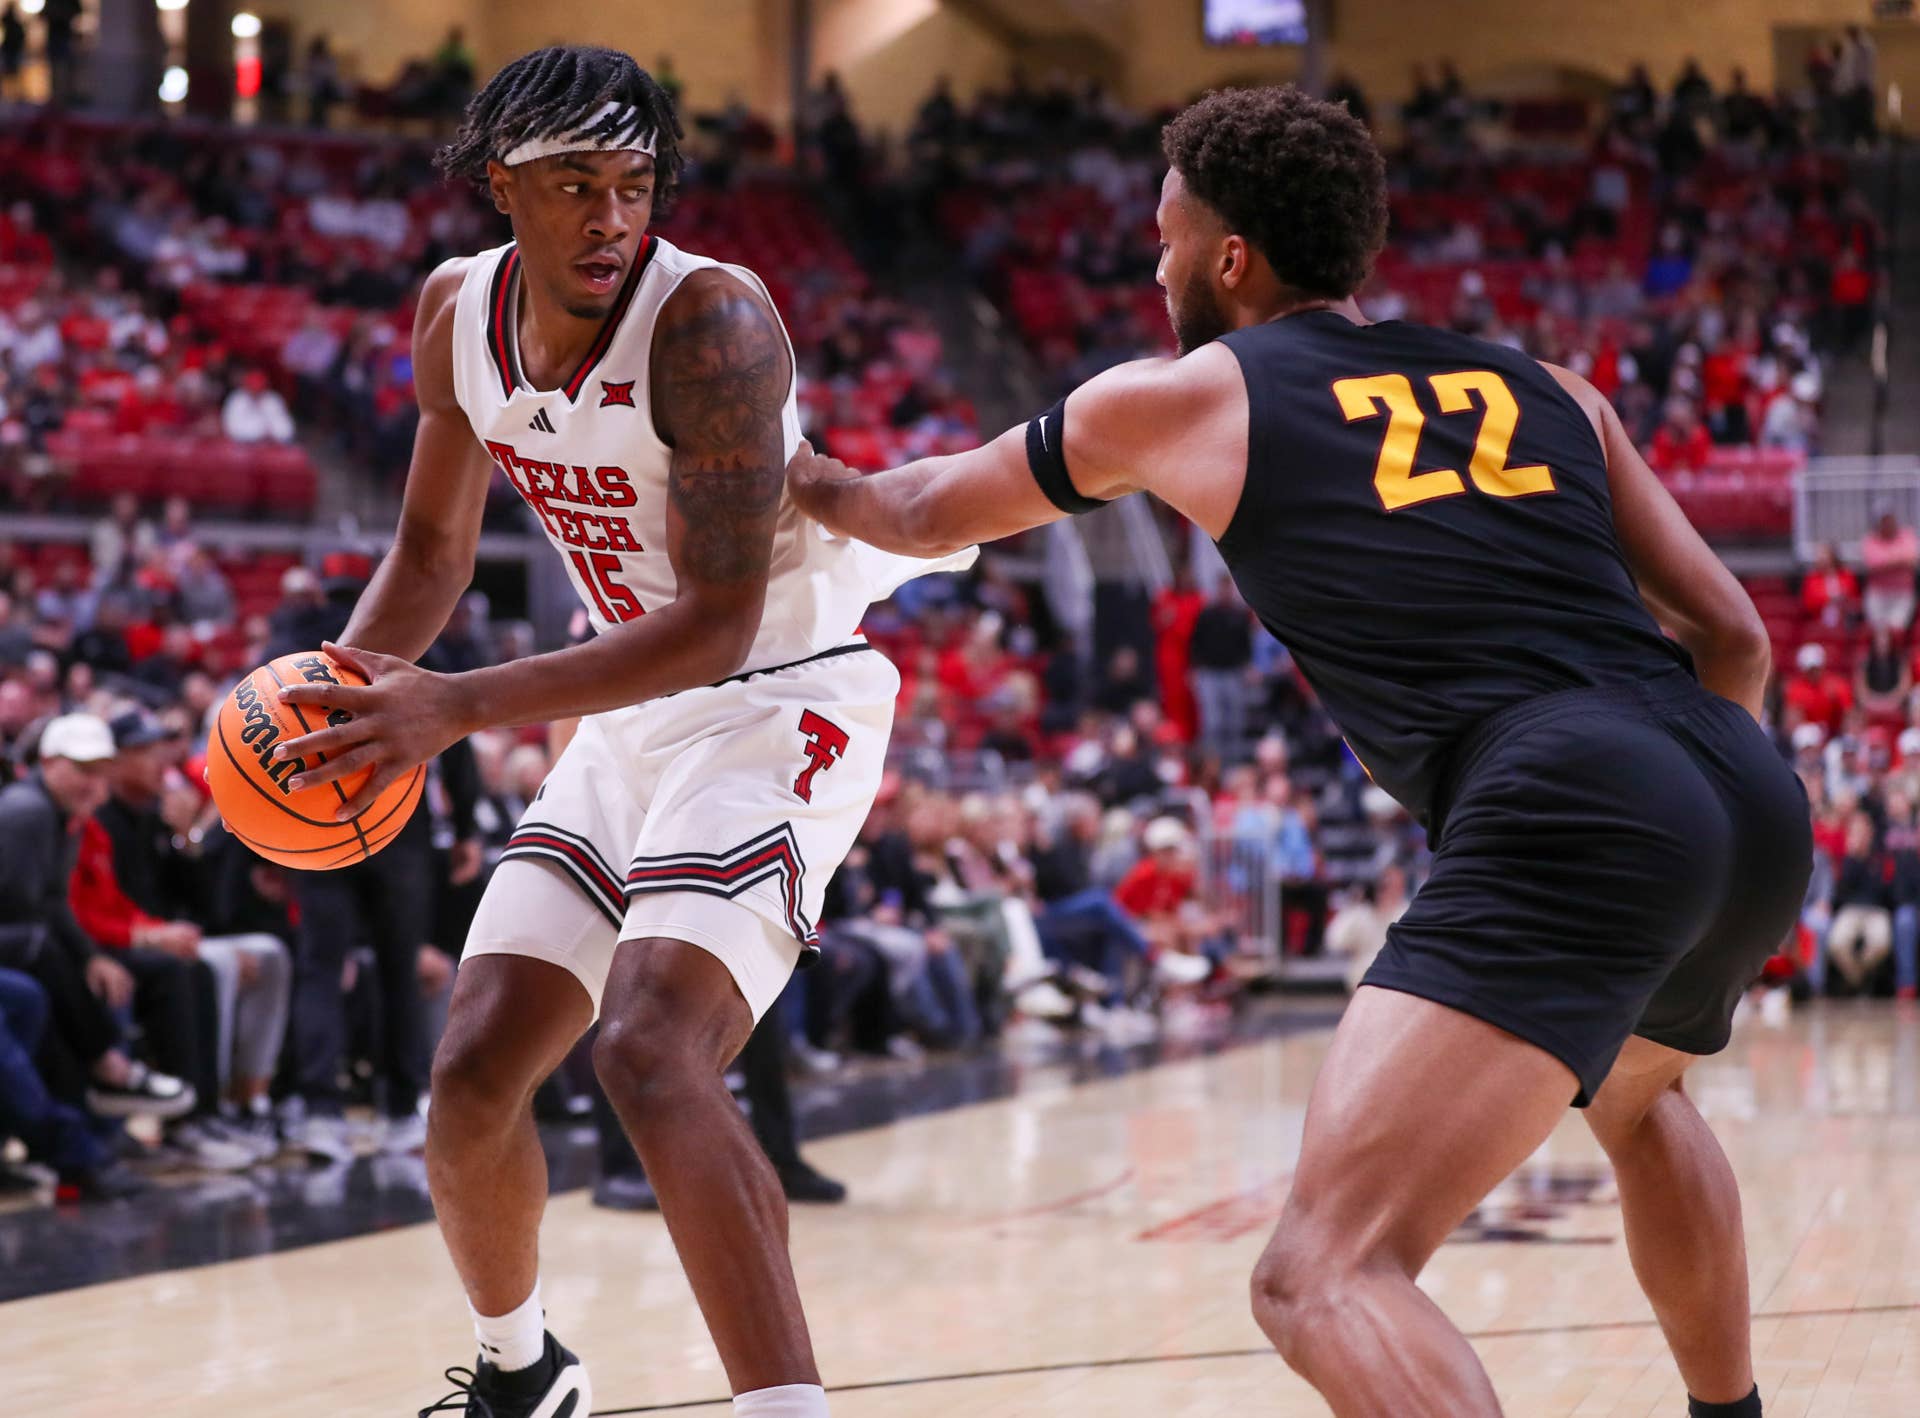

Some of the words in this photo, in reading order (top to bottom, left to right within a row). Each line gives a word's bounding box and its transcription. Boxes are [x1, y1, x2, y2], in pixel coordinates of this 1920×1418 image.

[484, 439, 638, 508] TEXAS
[1330, 369, 1559, 513] 22
[522, 492, 645, 552] TECH
[568, 550, 647, 623] 15
[235, 676, 306, 796] Wilson
